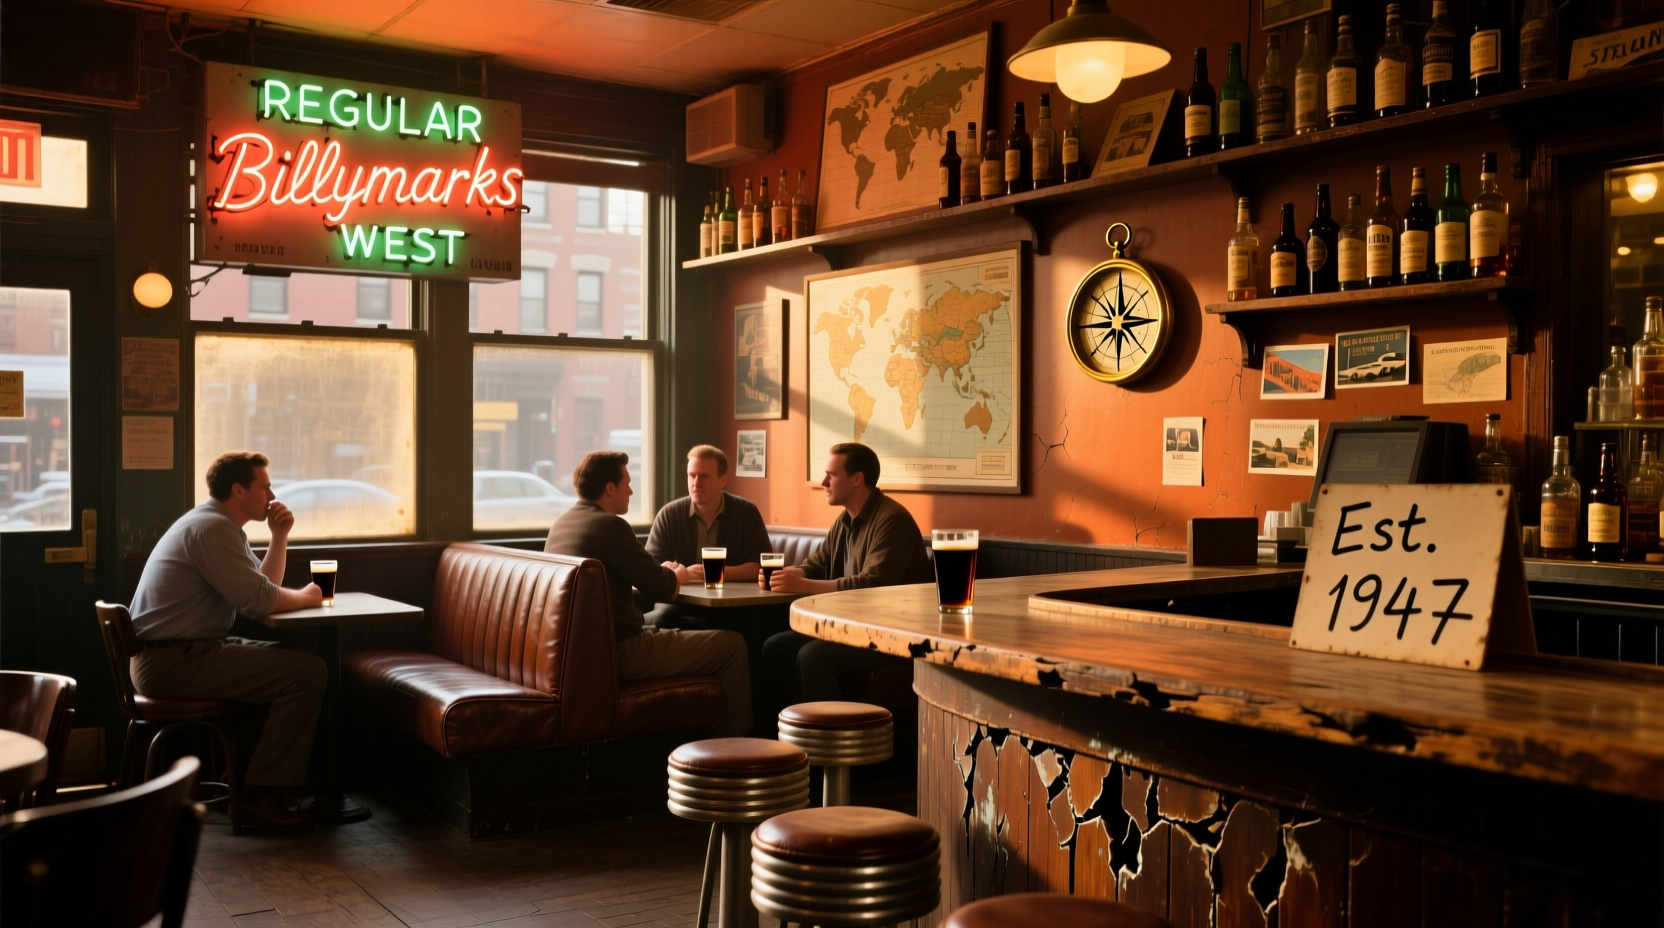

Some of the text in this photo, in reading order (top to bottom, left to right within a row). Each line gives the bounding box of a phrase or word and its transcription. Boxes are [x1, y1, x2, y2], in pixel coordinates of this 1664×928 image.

[263, 80, 482, 143] REGULAR
[215, 132, 524, 222] Billymarks
[341, 224, 465, 264] WEST
[1332, 501, 1437, 556] Est.
[1328, 574, 1473, 645] 1947
